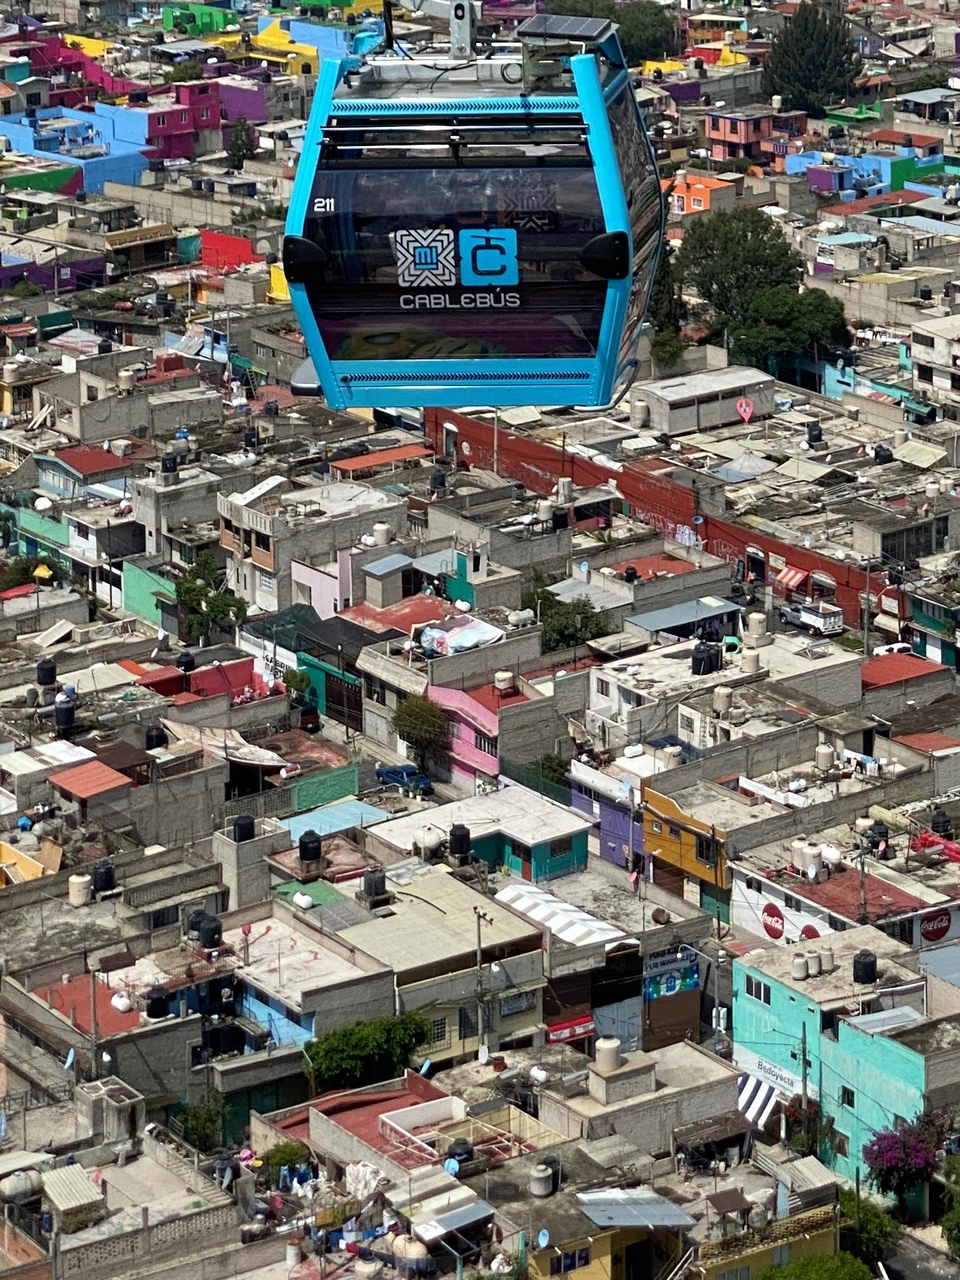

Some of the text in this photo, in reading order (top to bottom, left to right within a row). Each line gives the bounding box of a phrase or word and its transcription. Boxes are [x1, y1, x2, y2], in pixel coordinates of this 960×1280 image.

[313, 197, 335, 212] 211
[399, 287, 521, 309] CABLEBÚS
[757, 1060, 795, 1087] Bedoyecta
